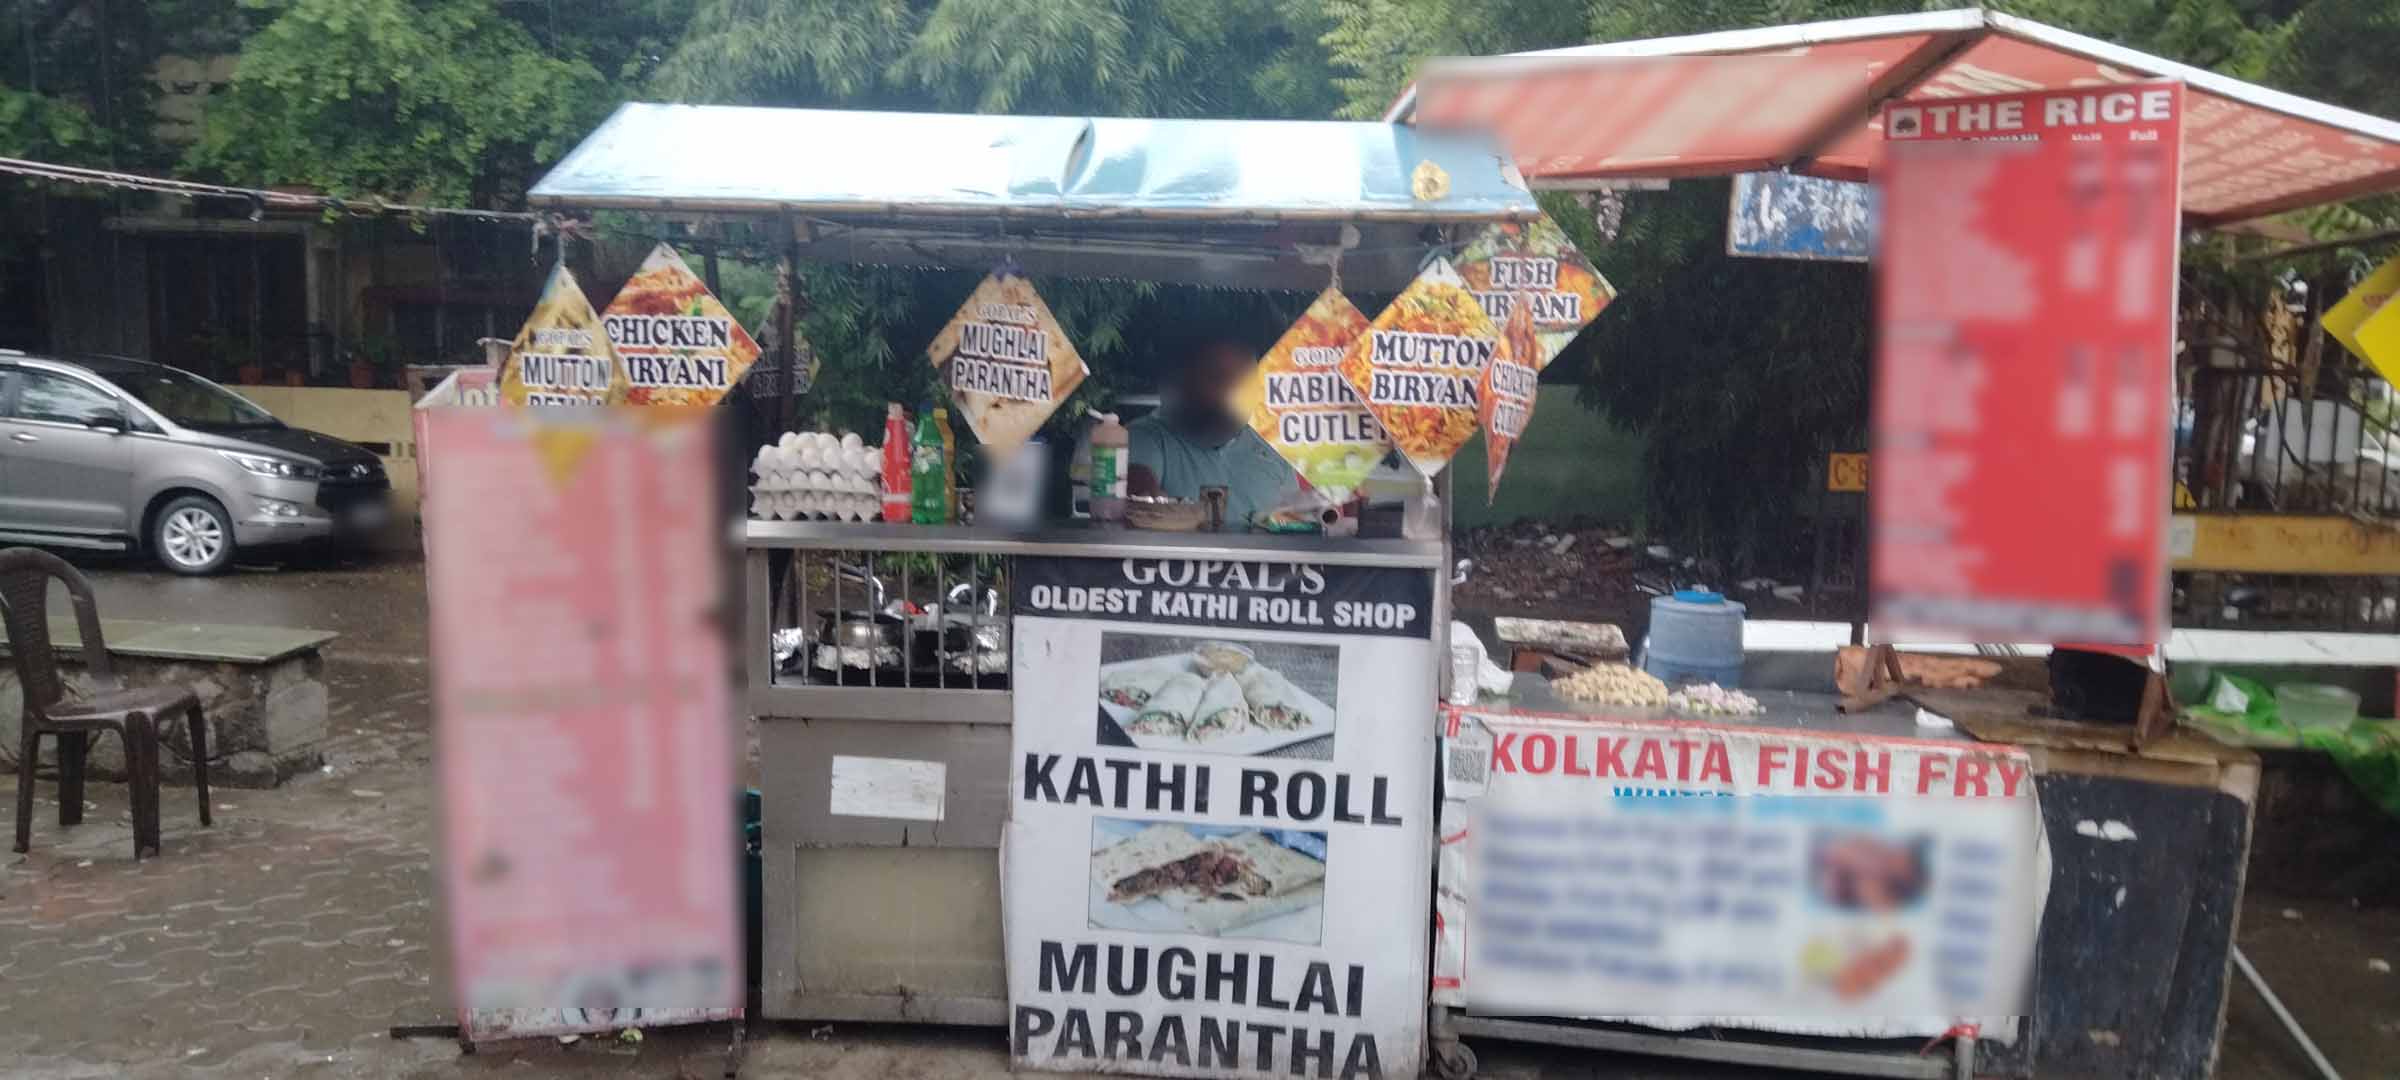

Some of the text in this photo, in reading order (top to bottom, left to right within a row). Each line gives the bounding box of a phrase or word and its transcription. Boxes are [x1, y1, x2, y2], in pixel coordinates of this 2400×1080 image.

[1926, 90, 2172, 133] THE RICE
[1493, 260, 1554, 284] FISH
[1475, 292, 1578, 319] IRANI
[604, 317, 728, 347] CHICKEN
[963, 323, 1046, 361] MUGHLAI
[1374, 332, 1494, 367] MUTTON
[524, 355, 609, 387] MUTTON
[626, 356, 726, 386] IRYANI
[955, 360, 1050, 400] PARANTHA
[1374, 373, 1478, 405] BIRYAN
[1121, 557, 1327, 596] GOPAL'S
[1031, 584, 1417, 630] OLDEST KATHI ROLL SHOP
[1491, 731, 2026, 799] KOLKATA FISH FRY
[1024, 752, 1403, 827] KATHI ROLL
[1038, 940, 1365, 1019] MUGHLAI
[1013, 1004, 1384, 1080] PARANTHA
